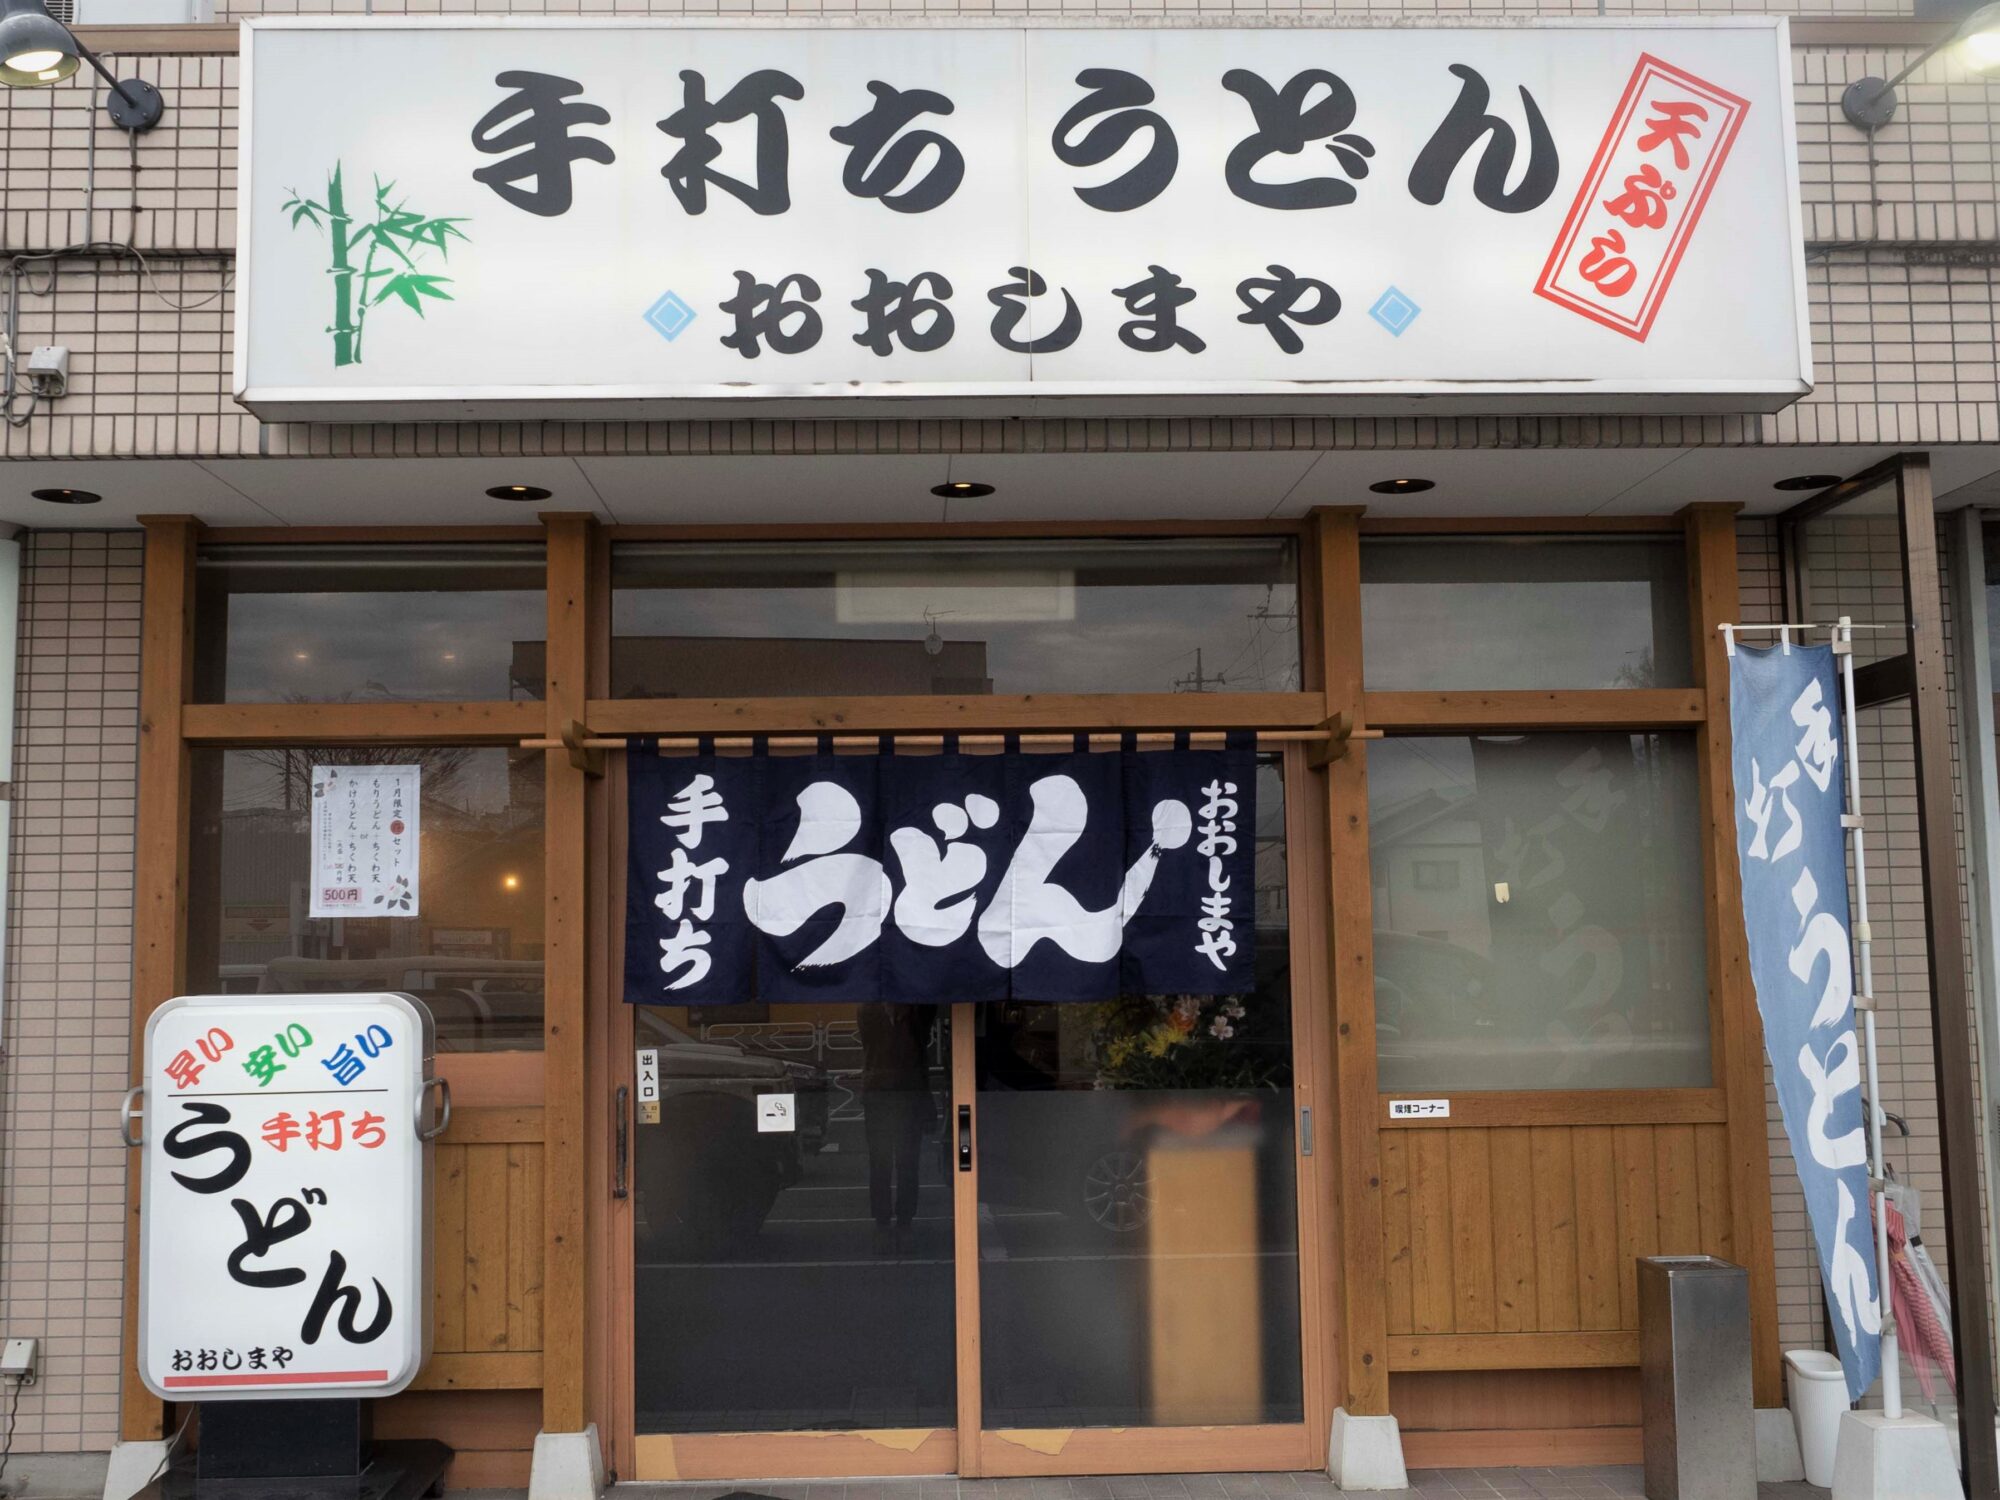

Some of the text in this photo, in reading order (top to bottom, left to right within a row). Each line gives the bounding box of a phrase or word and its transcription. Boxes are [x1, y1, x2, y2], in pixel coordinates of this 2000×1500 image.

[471, 63, 1560, 217] 手打ち うどん
[1579, 100, 1709, 297] 天ぷら
[719, 264, 1342, 359] おおしまや
[324, 889, 358, 901] 500円
[654, 773, 729, 990] 手打ち
[743, 774, 1192, 973] うどん
[1194, 779, 1238, 972] おおしまや
[165, 1023, 393, 1090] 早い 安い 旨い
[642, 1055, 654, 1097] 出入口
[261, 1111, 386, 1152] 手打ち
[1395, 1104, 1444, 1113] 喫煙コーナー
[163, 1102, 393, 1345] うどん
[172, 1346, 294, 1372] おおしまや
